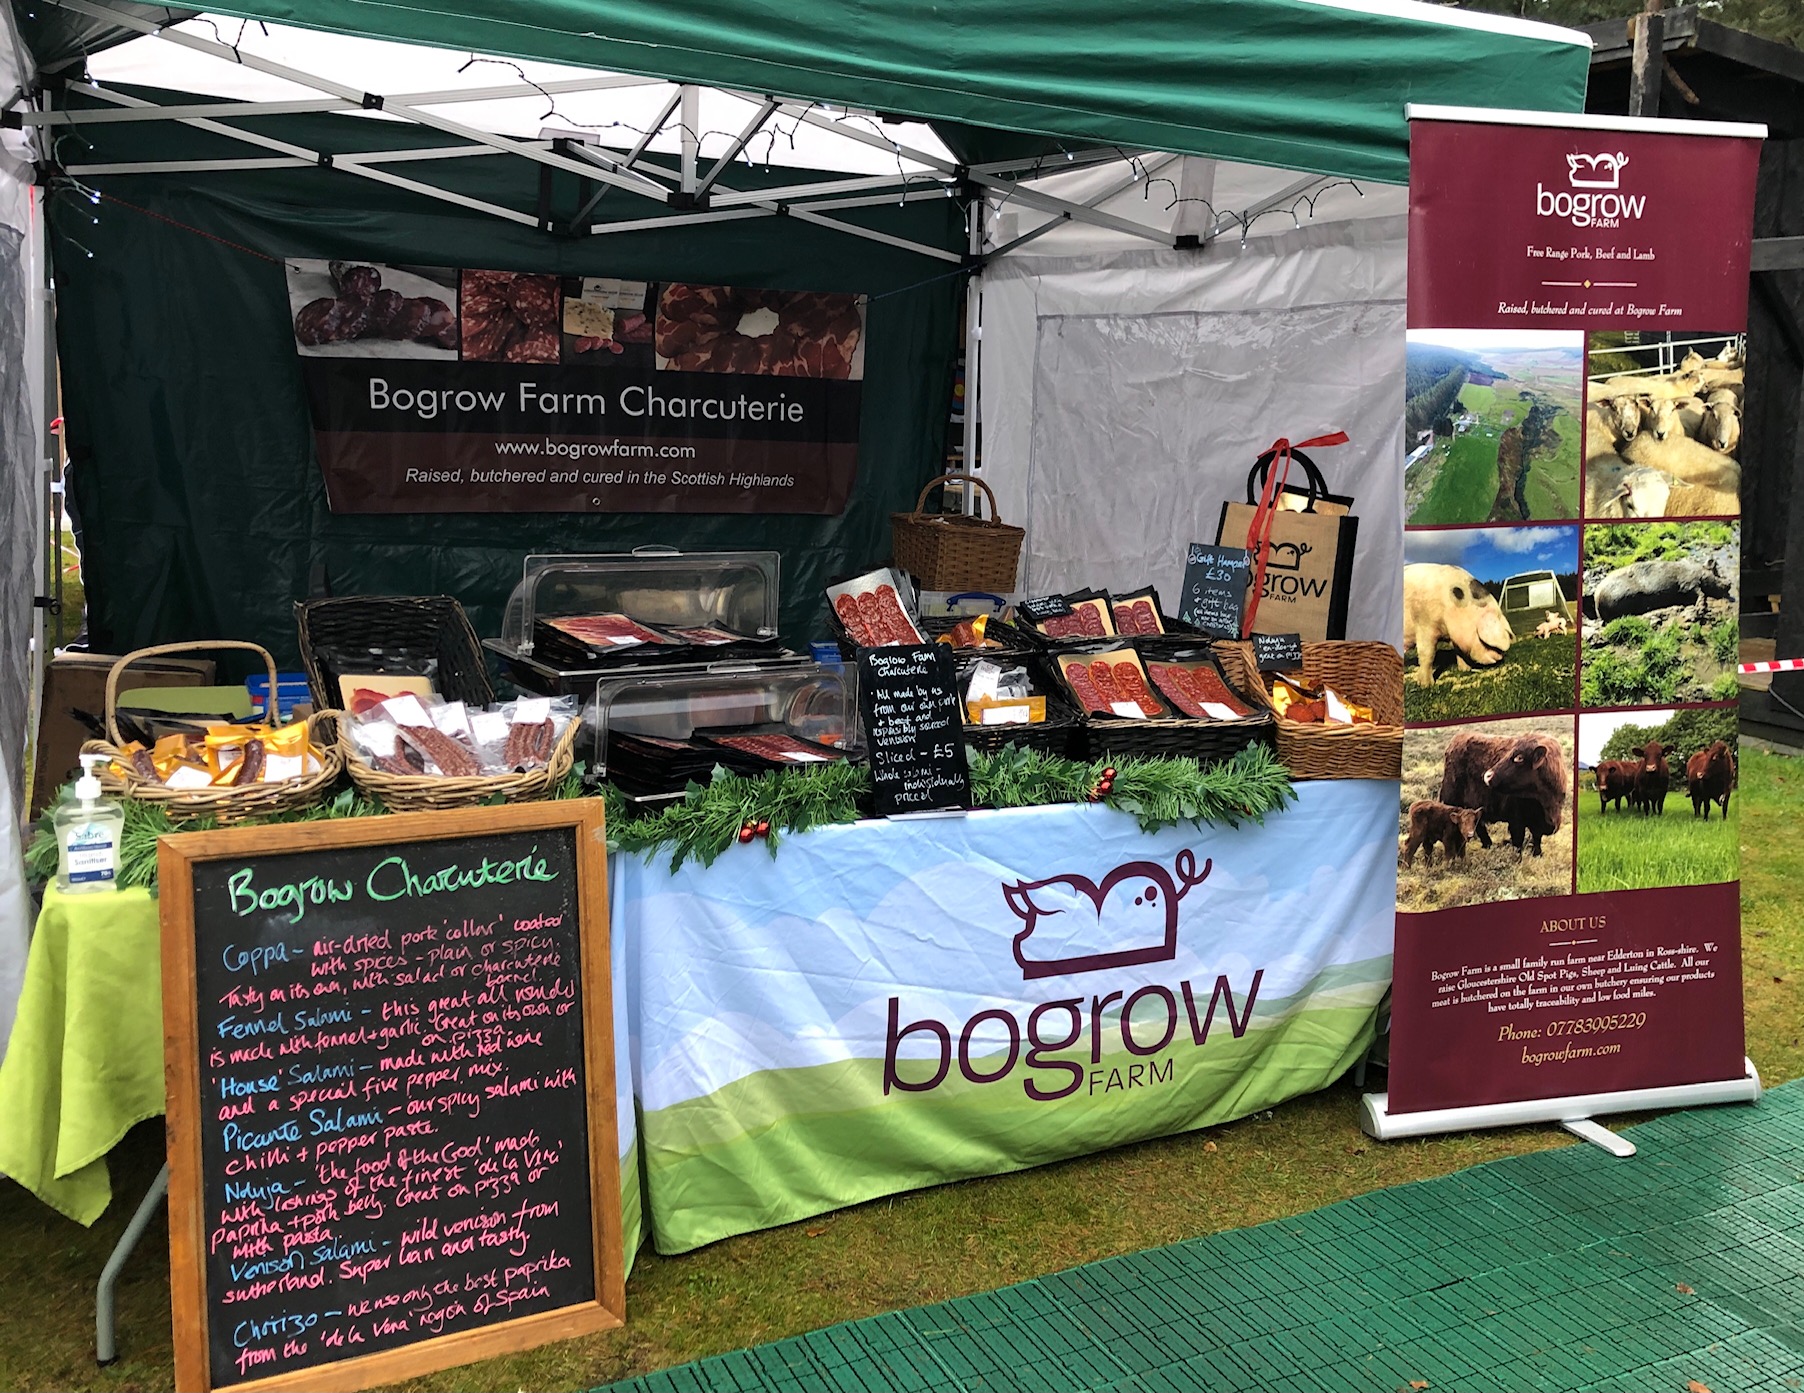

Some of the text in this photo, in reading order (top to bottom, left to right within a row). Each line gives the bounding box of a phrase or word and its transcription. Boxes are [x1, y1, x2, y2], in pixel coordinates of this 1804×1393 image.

[1537, 183, 1646, 227] bogrow
[1591, 217, 1620, 228] FARM
[1527, 246, 1655, 261] Free Range Pork, Beef and Lamb
[1498, 301, 1682, 318] Raised, butchered and cured at Bogrow Farm
[369, 378, 804, 423] Bogrow Farm Charcuterie
[495, 437, 696, 460] www.bogrowfarm.com
[405, 468, 794, 488] Raised, butchered and cured in the Scottish Highlands
[1205, 567, 1231, 582] £30
[1269, 593, 1297, 604] FARM
[893, 688, 914, 698] made
[916, 685, 928, 700] by
[876, 743, 954, 765] Sliced £5
[228, 867, 353, 924] Bogrow
[1540, 916, 1607, 933] ABOUT US
[223, 942, 289, 976] Coppa
[401, 925, 439, 955] pork
[311, 956, 347, 977] with
[428, 944, 472, 967] plain
[481, 943, 496, 956] or
[1431, 970, 1459, 982] Bogrow
[1462, 966, 1482, 976] Farm
[1484, 965, 1491, 973] is
[1500, 958, 1520, 971] small
[1523, 956, 1548, 969] family
[1550, 958, 1565, 966] run
[1567, 953, 1586, 965] farm
[1588, 955, 1605, 964] near
[1607, 949, 1643, 961] Edderton
[1646, 948, 1654, 957] in
[1657, 943, 1699, 956] Ross-shire.
[1704, 942, 1718, 952] We
[219, 985, 264, 1013] Tasty
[290, 983, 310, 1000] its
[394, 964, 445, 986] salad
[450, 965, 467, 977] or
[1432, 999, 1450, 1009] meat
[1453, 996, 1459, 1005] is
[1460, 987, 1498, 1003] butchered
[1513, 985, 1526, 996] the
[1528, 983, 1547, 996] farm
[1550, 982, 1558, 992] in
[1560, 984, 1574, 992] our
[1576, 981, 1592, 991] own
[1594, 976, 1628, 989] butchery
[1630, 975, 1664, 985] ensuring
[1666, 974, 1680, 982] our
[1681, 969, 1715, 982] products
[1438, 983, 1455, 994] raise
[1457, 973, 1516, 991] Gloucestershire
[1518, 971, 1534, 982] Old
[1537, 971, 1557, 982] Spot
[1559, 969, 1579, 980] Pigs,
[1582, 966, 1605, 978] Sheep
[1607, 962, 1622, 974] and
[1624, 962, 1648, 973] Luing
[1650, 958, 1676, 971] Cattle.
[1681, 957, 1693, 968] All
[217, 982, 508, 1039] Fennel Salami this great all
[1488, 987, 1656, 1013] have totally traceability and low food miles.
[209, 1047, 225, 1068] is
[555, 1001, 575, 1016] or
[422, 1033, 446, 1046] on
[882, 969, 1265, 1102] bogrow
[1498, 1012, 1647, 1041] Phone: 07783995229
[288, 1049, 425, 1085] Salami made
[1521, 1041, 1621, 1067] bogrowfarm.com
[1089, 1058, 1175, 1096] FARM
[219, 1076, 398, 1121] and a five
[223, 1067, 576, 1152] Picante Salami our salami with
[316, 1131, 378, 1161] pepper
[354, 1151, 391, 1178] food
[370, 1172, 398, 1192] the
[402, 1166, 468, 1191] finest
[502, 1153, 519, 1169] la
[448, 1186, 471, 1198] on
[528, 1167, 550, 1183] or
[230, 1251, 305, 1282] Venison
[401, 1216, 439, 1246] wild
[512, 1198, 559, 1233] from
[442, 1236, 474, 1257] and
[234, 1249, 572, 1348] Chorizo the paprika
[235, 1347, 276, 1376] from
[283, 1339, 308, 1356] the
[348, 1325, 365, 1343] la
[495, 1281, 550, 1313] Spain
